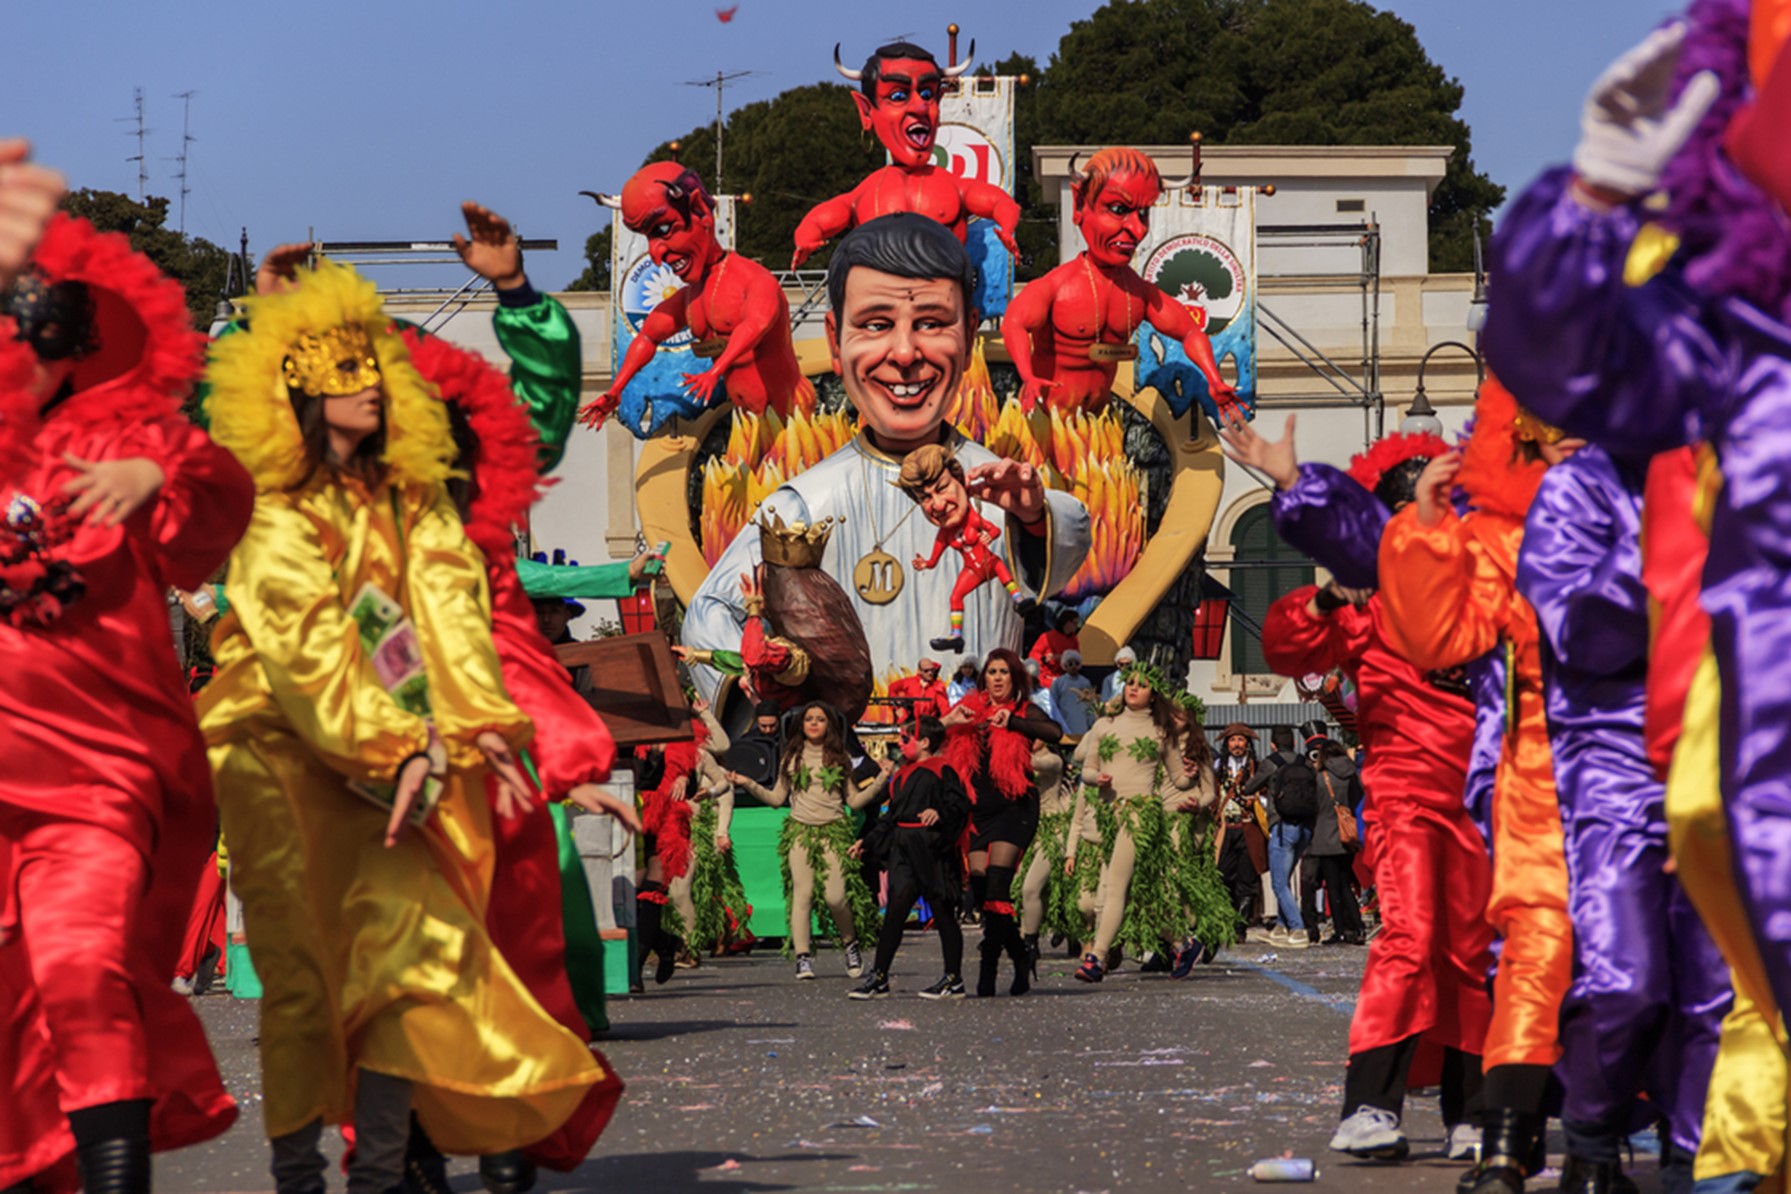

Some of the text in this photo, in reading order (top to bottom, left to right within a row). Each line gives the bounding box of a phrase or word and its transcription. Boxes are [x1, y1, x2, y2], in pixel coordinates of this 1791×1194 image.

[1158, 237, 1210, 259] DEMOCRATICO
[1210, 242, 1230, 260] DELLA
[859, 560, 896, 593] M
